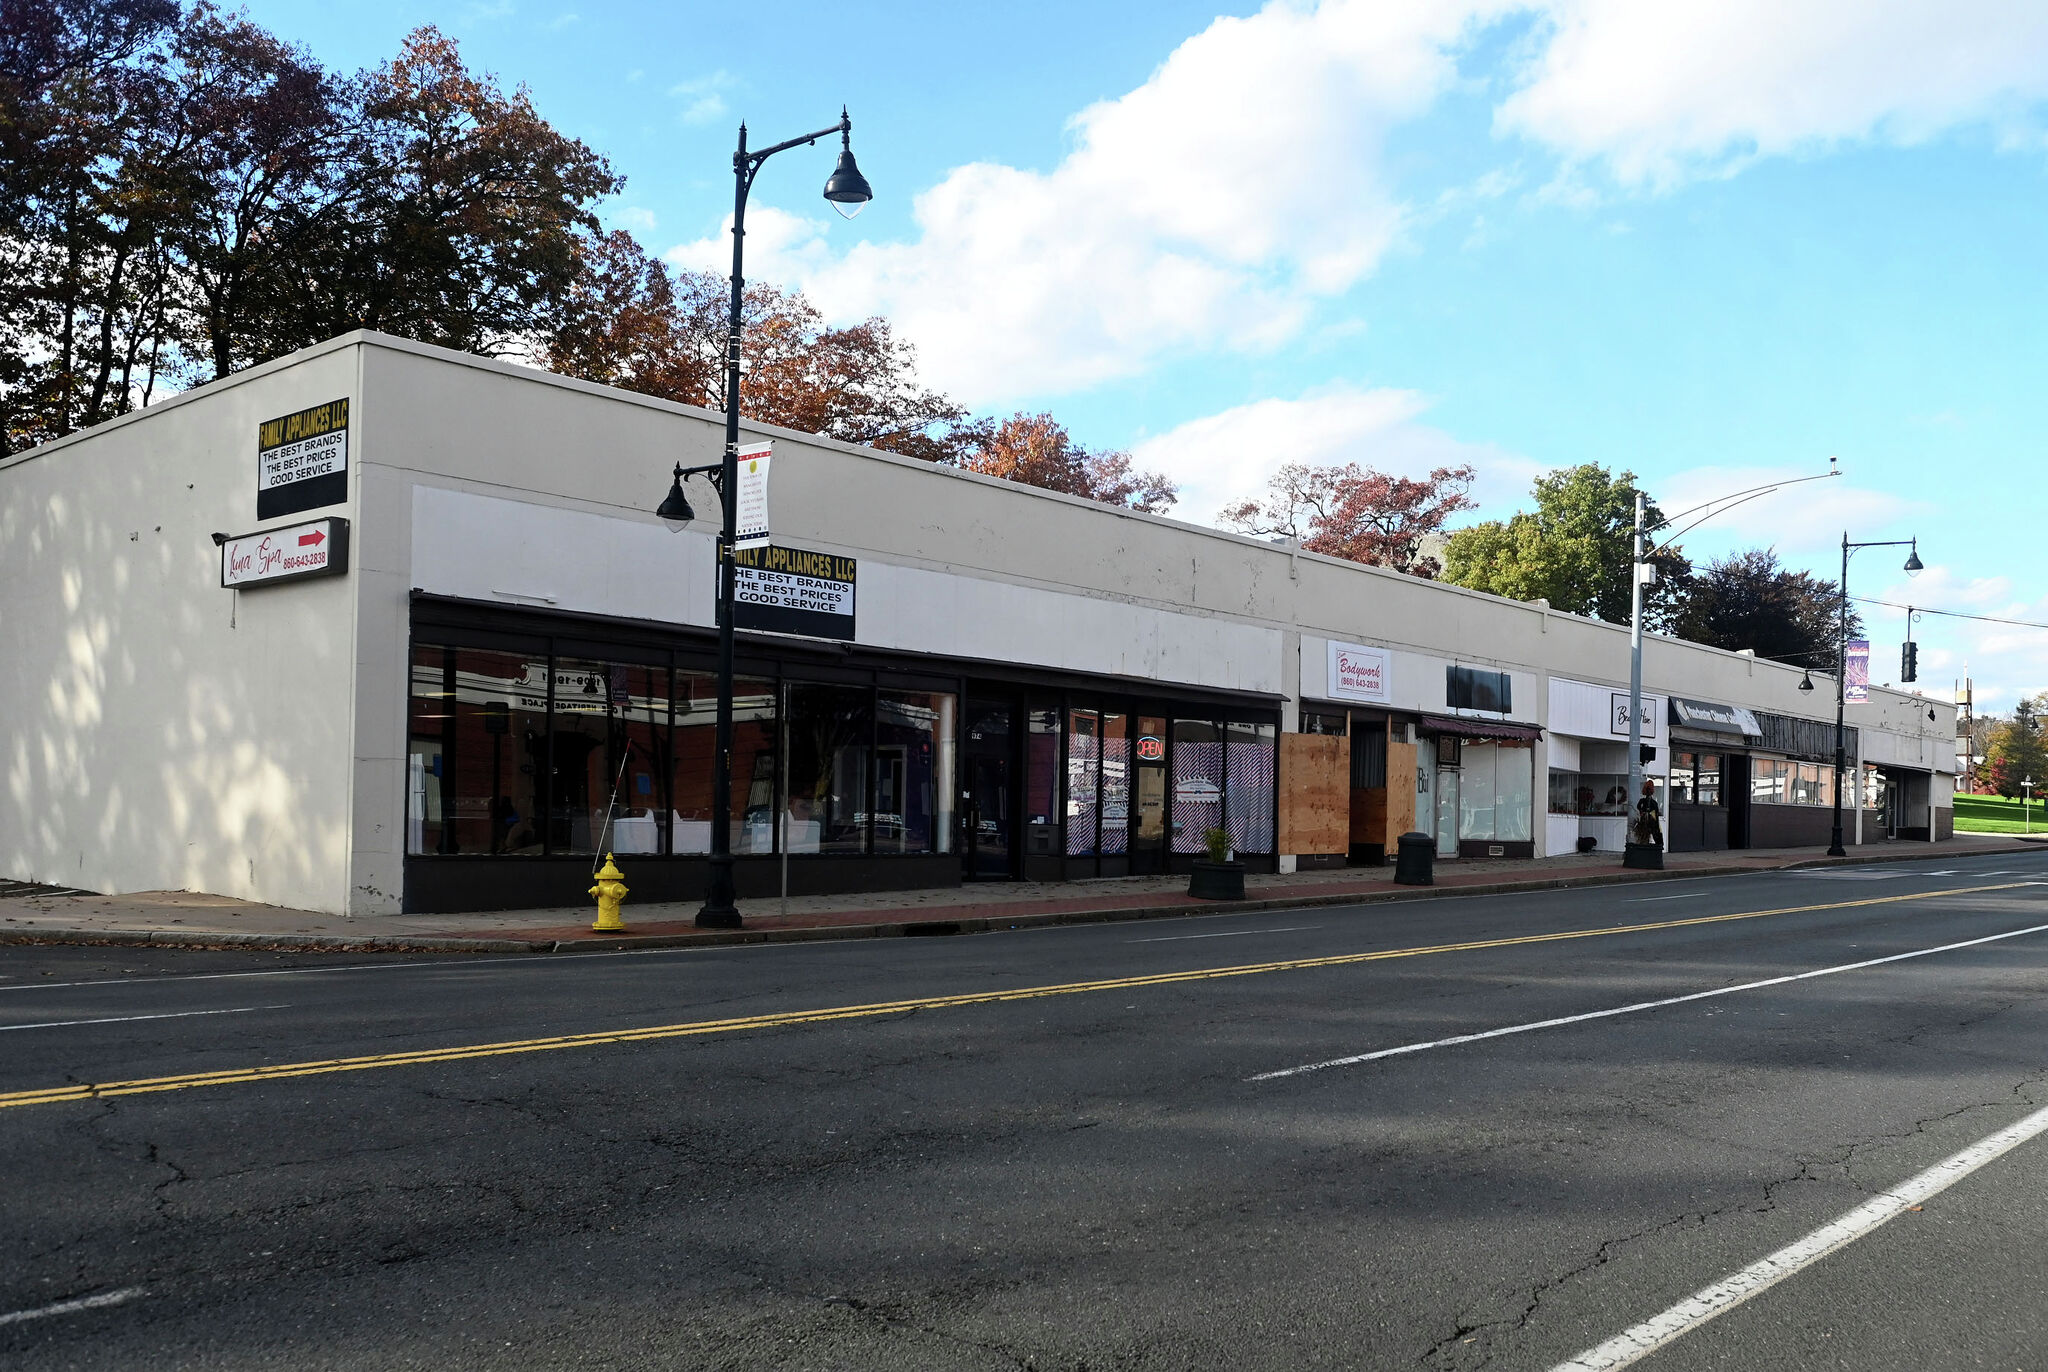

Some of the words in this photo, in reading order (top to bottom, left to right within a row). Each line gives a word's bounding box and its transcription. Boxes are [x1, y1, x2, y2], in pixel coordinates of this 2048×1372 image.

[260, 418, 284, 449] FAMILY
[286, 405, 330, 441] APPLIANCES
[332, 400, 347, 429] LLC
[263, 450, 278, 463] THE
[281, 443, 302, 458] BEST
[305, 433, 342, 451] BRANDS
[267, 462, 281, 474] THE
[284, 456, 304, 470] BEST
[307, 448, 336, 464] PRICES
[270, 471, 293, 485] GOOD
[296, 462, 332, 479] SERVICE
[229, 544, 251, 579] Luna
[256, 536, 282, 574] Spa
[283, 552, 326, 569] 860-643-2838
[765, 547, 832, 578] APPLIANCES
[836, 558, 854, 582] LLC
[734, 580, 759, 591] THE
[764, 584, 796, 596] BEST
[800, 589, 842, 602] PRICES
[735, 568, 753, 579] HE
[758, 571, 792, 584] BEST
[797, 577, 849, 592] BRANDS
[740, 592, 779, 604] GOOD
[784, 597, 836, 612] SERVICE
[1340, 658, 1380, 679] Bodywork
[1137, 740, 1163, 756] OPEN
